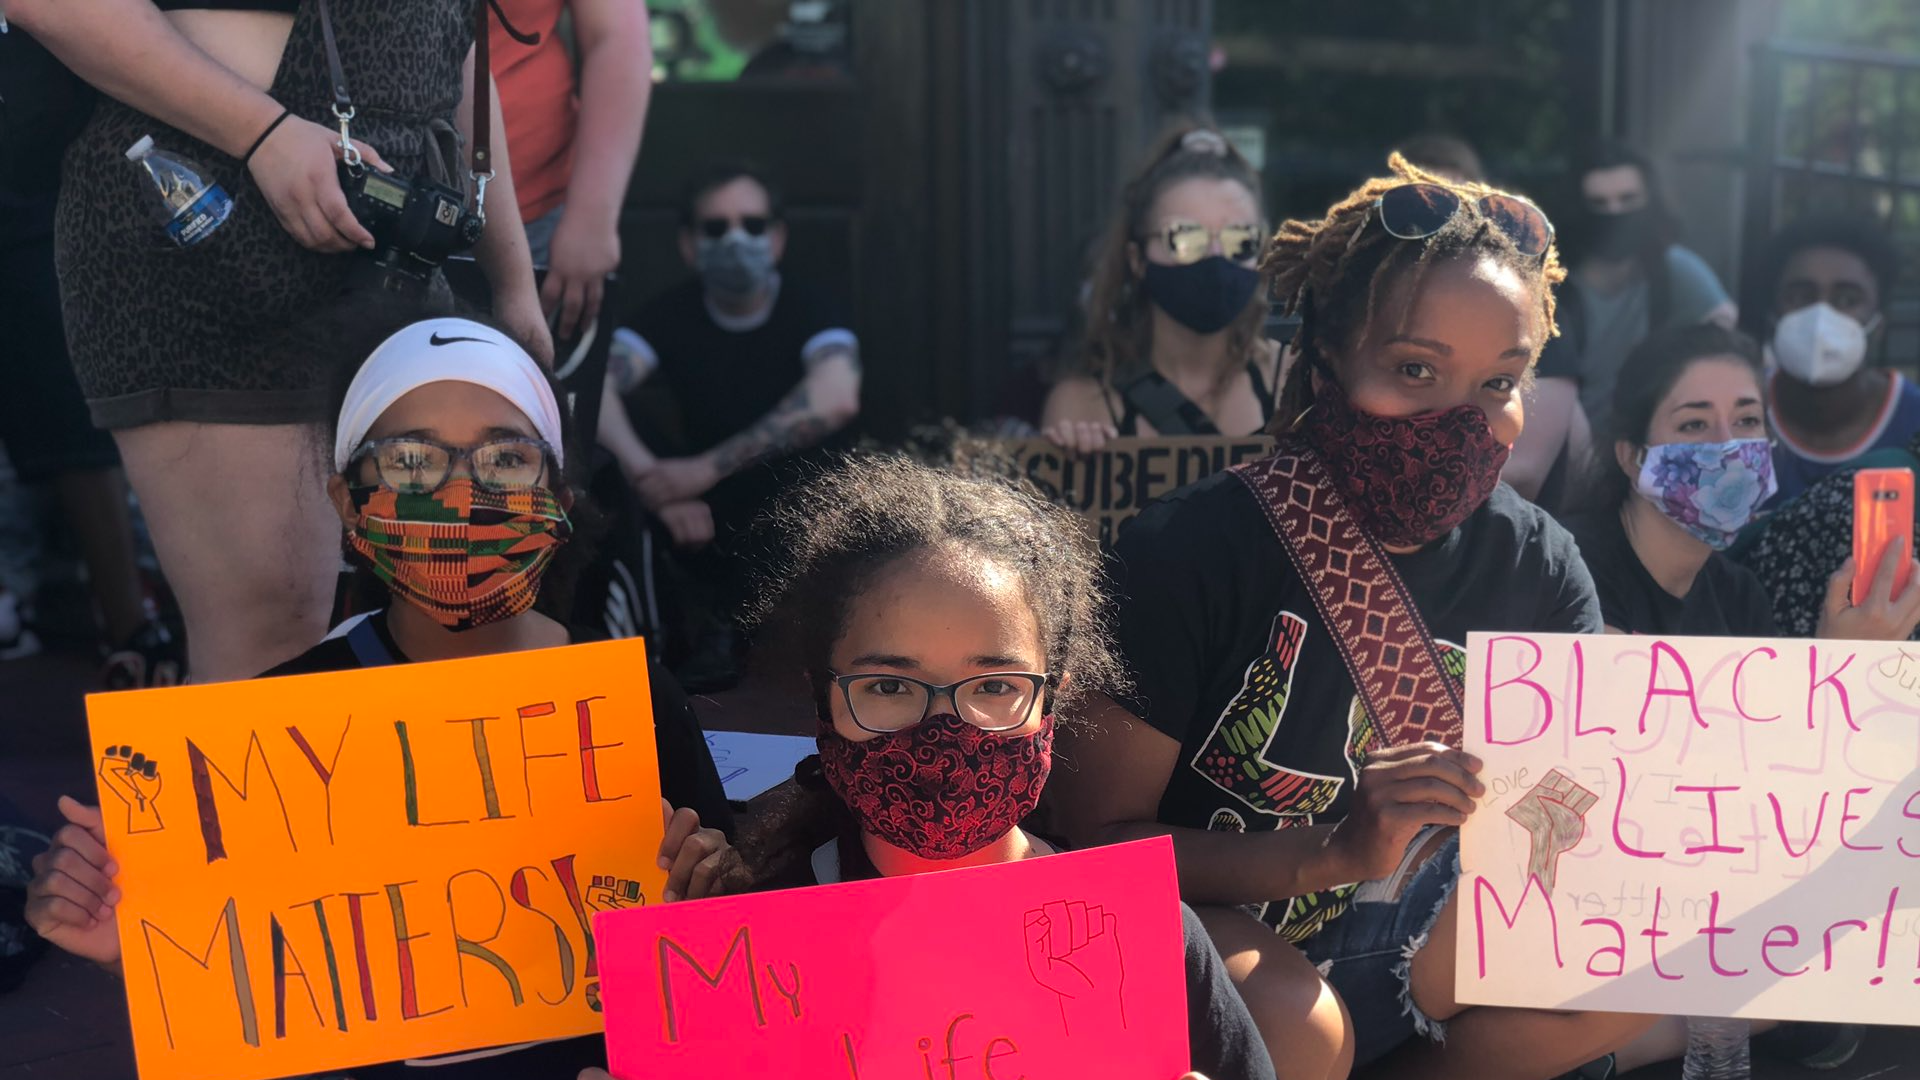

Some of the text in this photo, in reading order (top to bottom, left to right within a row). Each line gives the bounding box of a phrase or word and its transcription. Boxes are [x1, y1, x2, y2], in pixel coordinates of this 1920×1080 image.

[1484, 636, 1862, 744] BLACK
[185, 696, 632, 864] MY LIFE
[140, 854, 602, 1050] MATTERS!
[658, 926, 801, 1042] My
